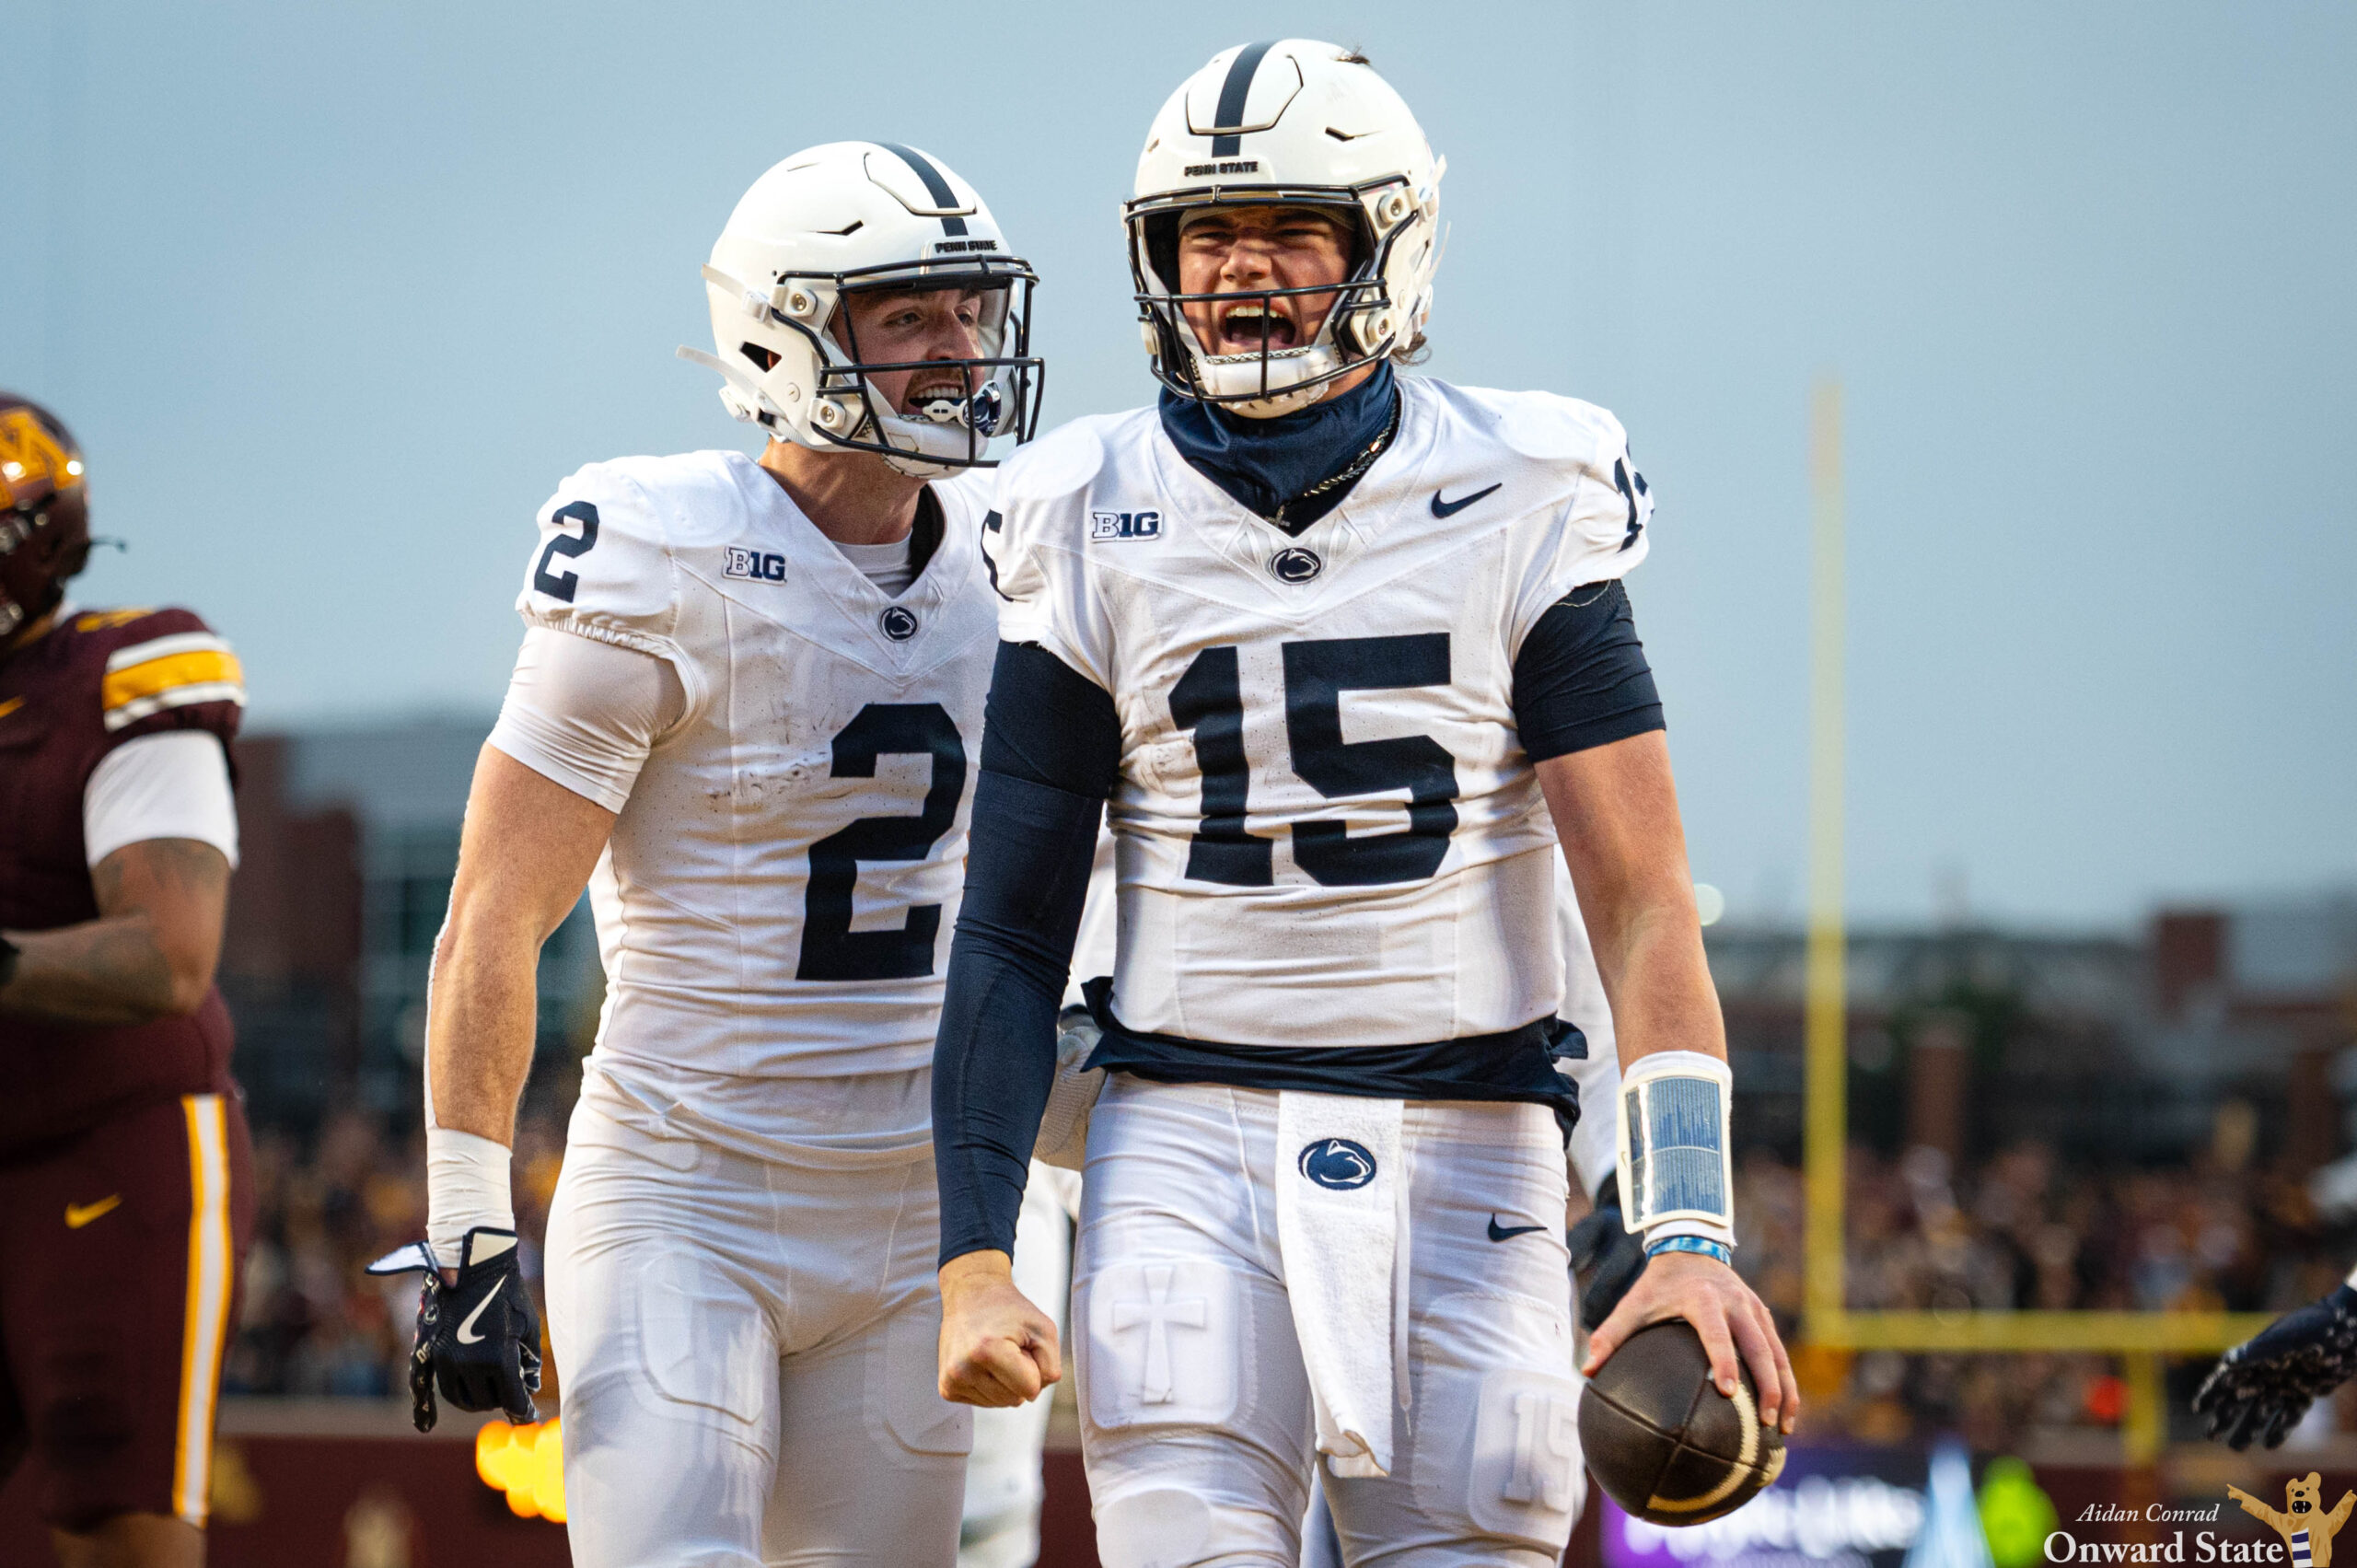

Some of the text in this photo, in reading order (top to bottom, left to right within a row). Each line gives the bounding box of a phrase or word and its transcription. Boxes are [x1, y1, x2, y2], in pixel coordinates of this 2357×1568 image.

[1184, 161, 1259, 177] PENN STATE
[935, 239, 997, 253] PENN STATE
[534, 500, 599, 603] 2
[1168, 633, 1459, 887] 15
[795, 703, 967, 981] 2
